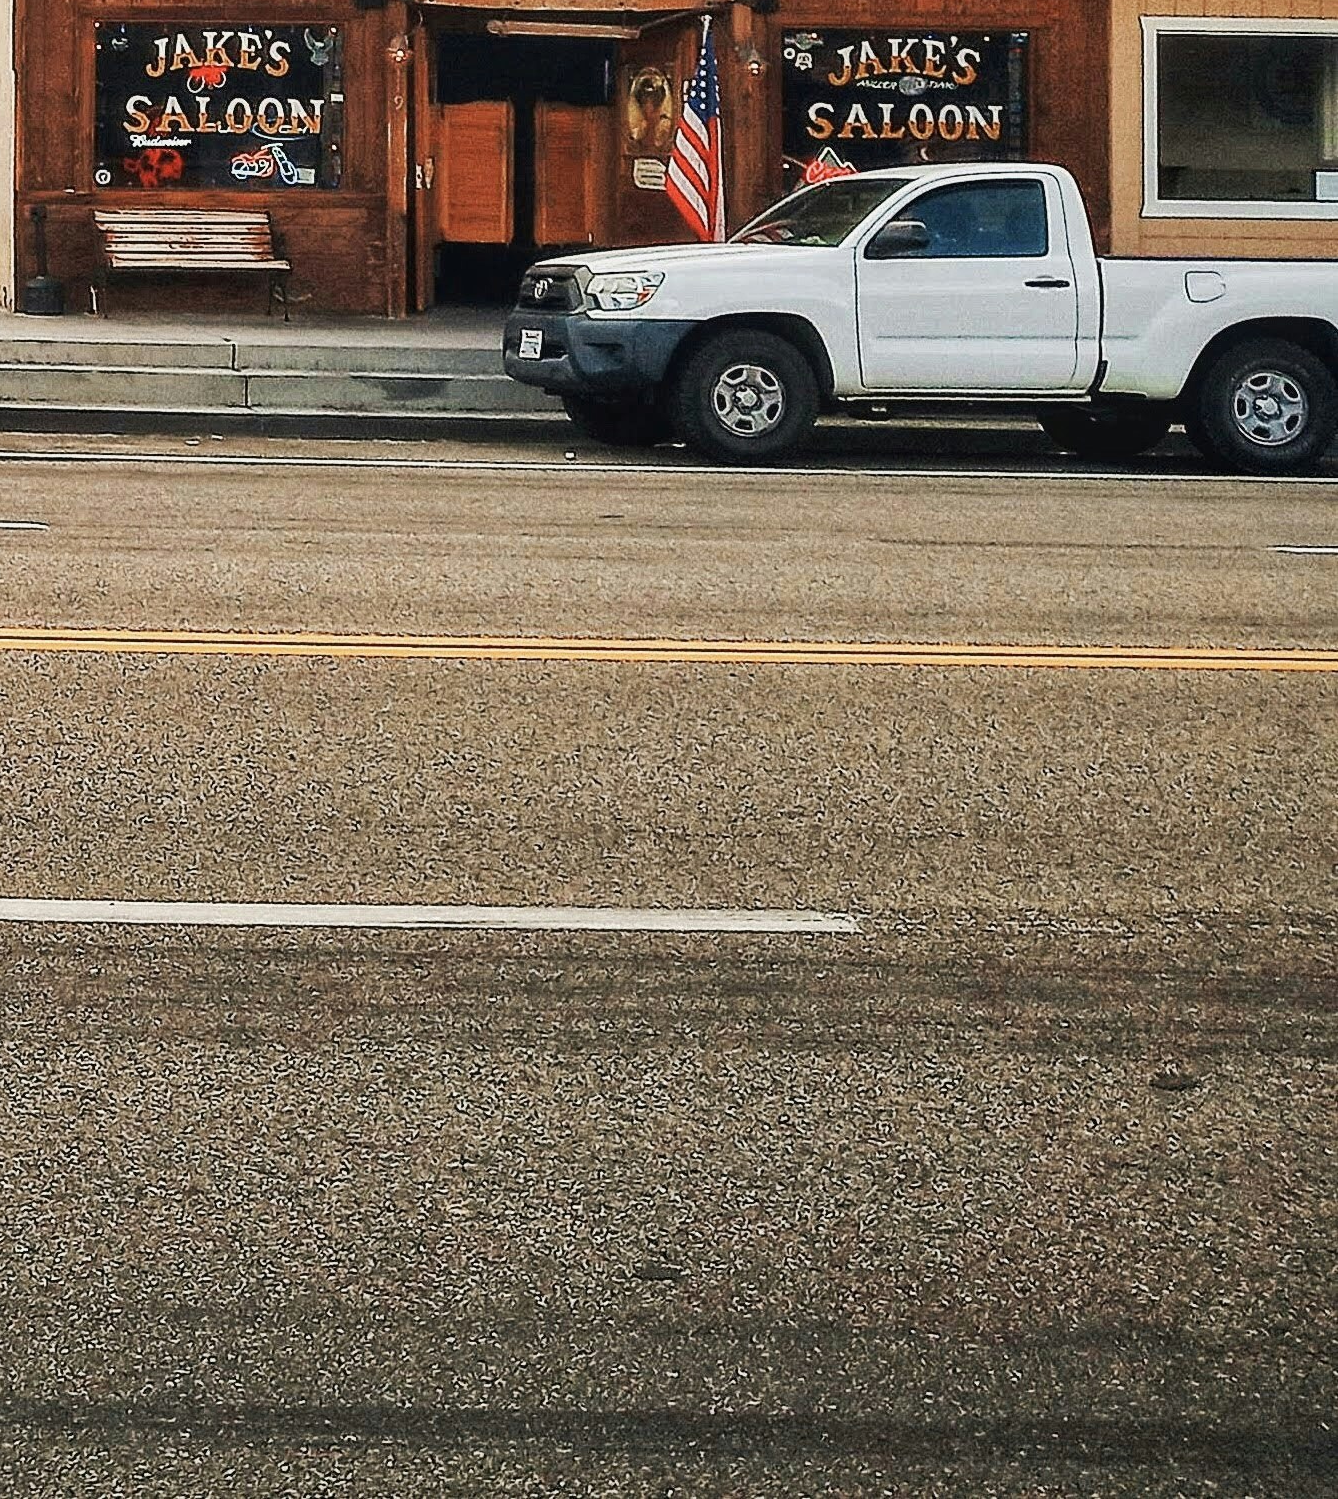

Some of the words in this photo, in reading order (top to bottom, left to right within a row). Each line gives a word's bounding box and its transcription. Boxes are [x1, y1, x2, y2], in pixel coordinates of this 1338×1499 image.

[145, 29, 291, 78] JAKE'S
[827, 35, 981, 87] JAKE'S
[122, 94, 326, 134] SALOON
[805, 102, 1003, 140] SALOON
